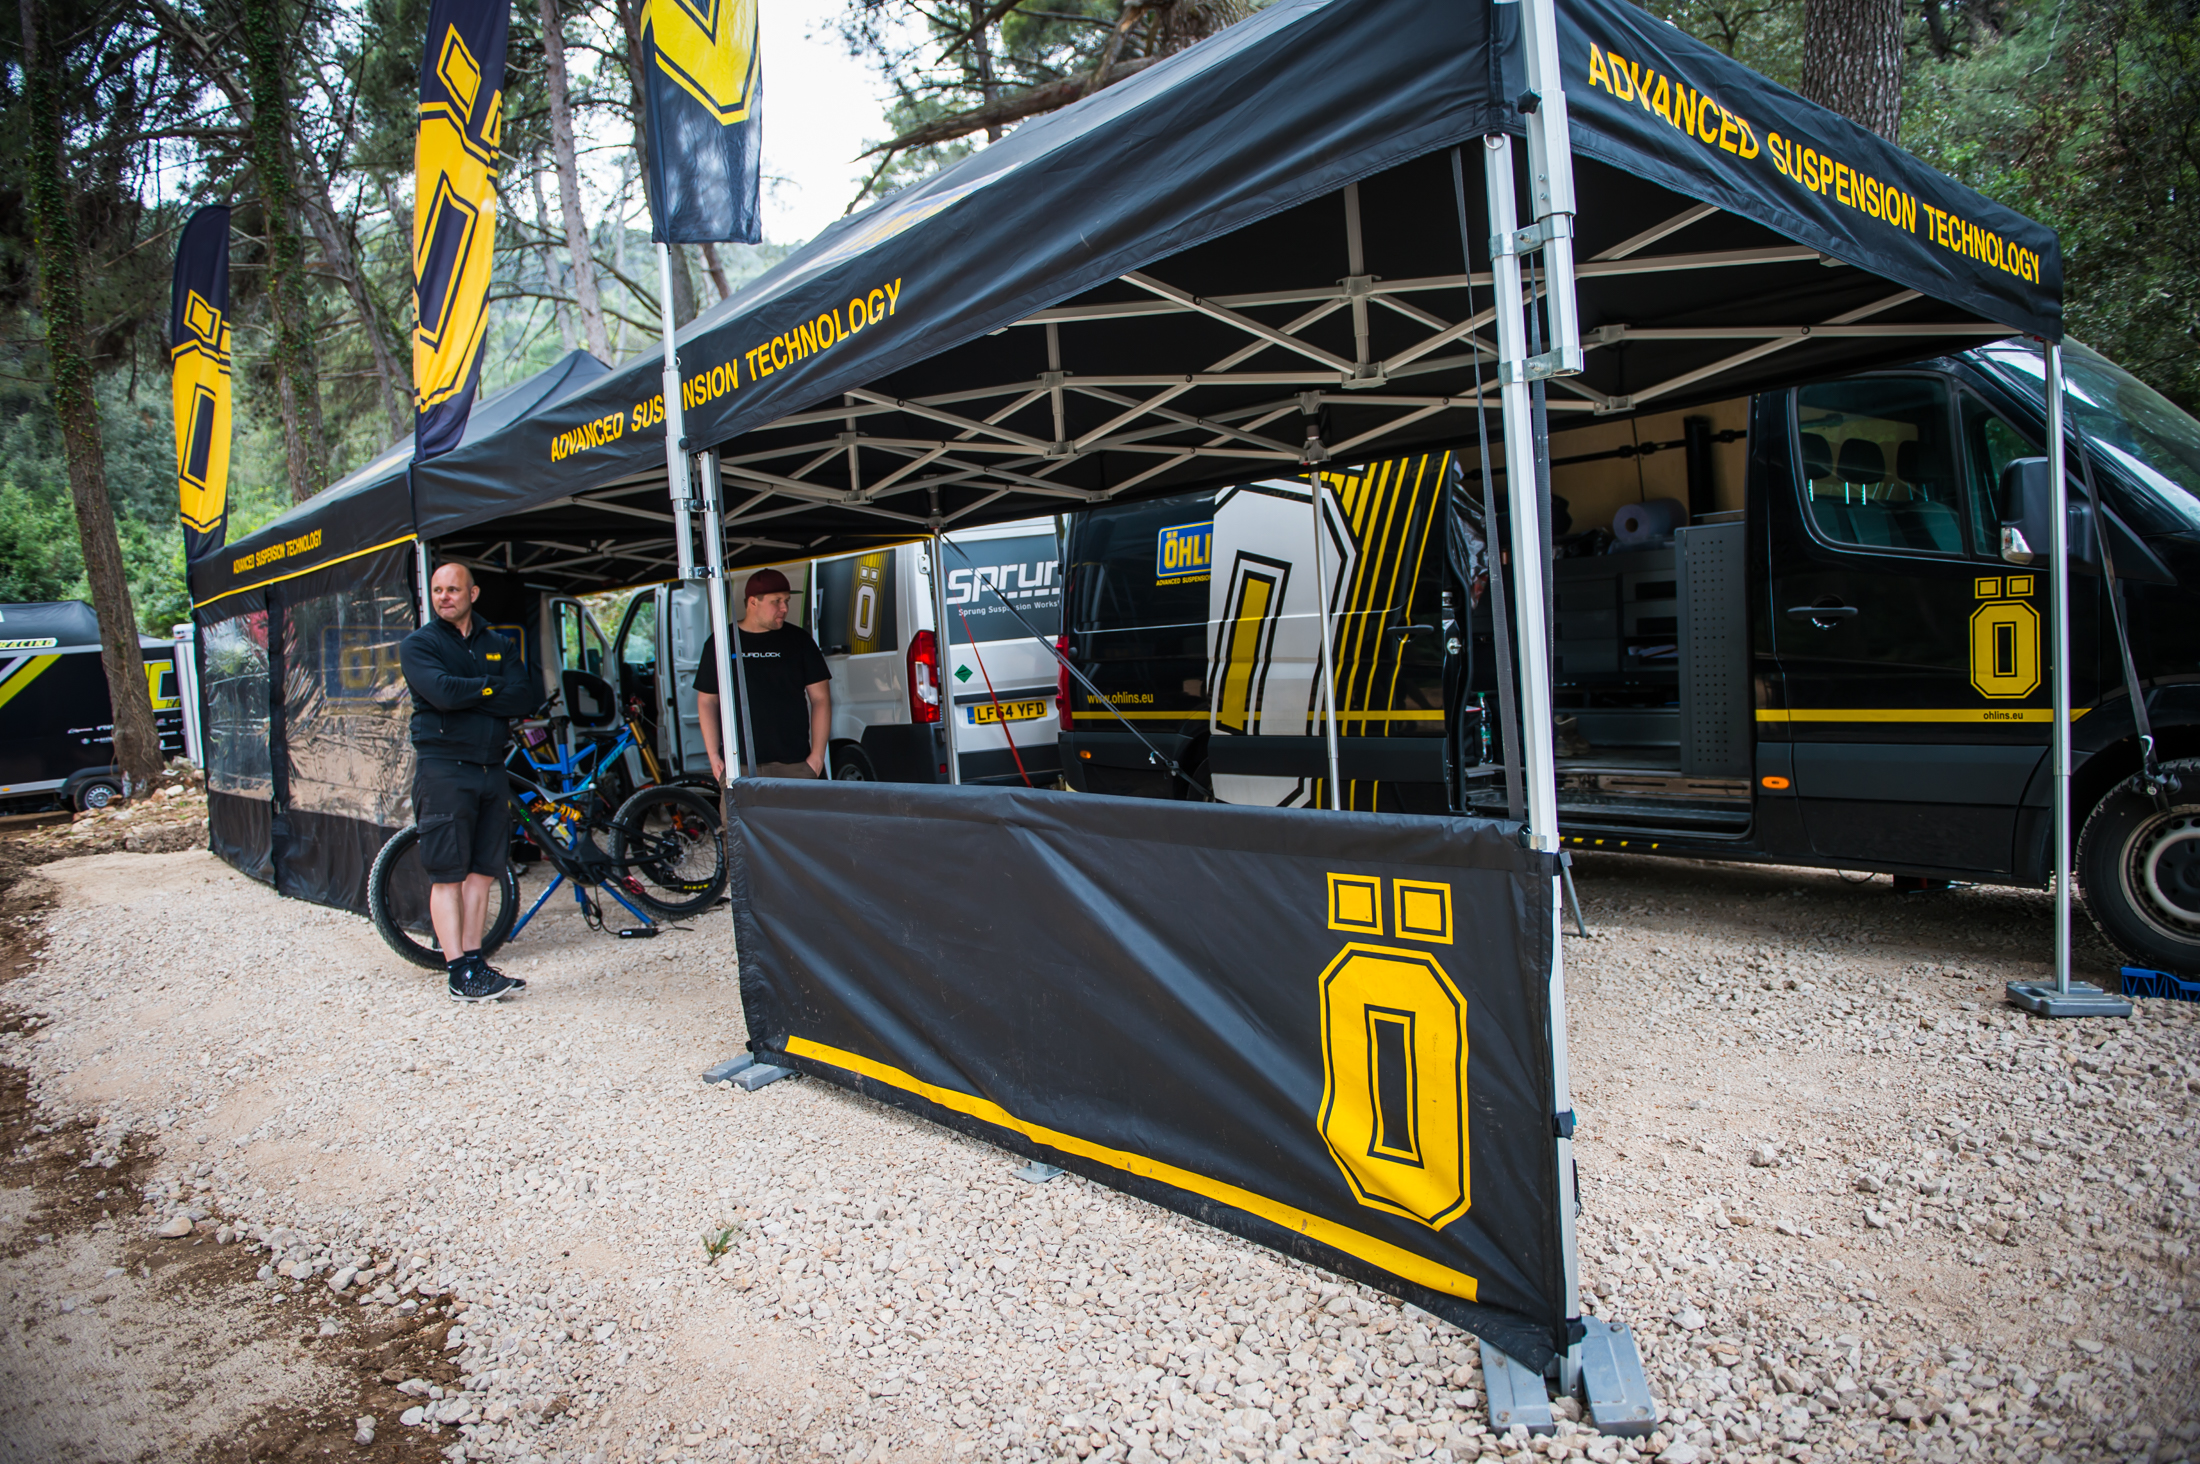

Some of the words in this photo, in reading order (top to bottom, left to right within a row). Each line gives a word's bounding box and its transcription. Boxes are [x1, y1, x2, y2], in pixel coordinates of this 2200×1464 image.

[1589, 43, 1760, 160] ADVANCED
[1767, 132, 1917, 234] SUSPENSION
[1922, 203, 2040, 285] TECHNOLOGY
[551, 412, 625, 463] ADVANCED
[630, 359, 740, 432] SUSNSION
[745, 277, 902, 382] TECHNOLOGY
[233, 553, 255, 575] ADVANCED
[256, 542, 286, 567] SUSPENSION
[286, 528, 323, 557] TECHNOLOGY
[959, 607, 986, 616] Sprung
[988, 602, 1031, 613] Suspsion
[1034, 599, 1060, 609] Works
[977, 705, 1014, 721] LF64
[1017, 702, 1045, 717] YFD
[1983, 711, 2024, 720] ohlins.eu
